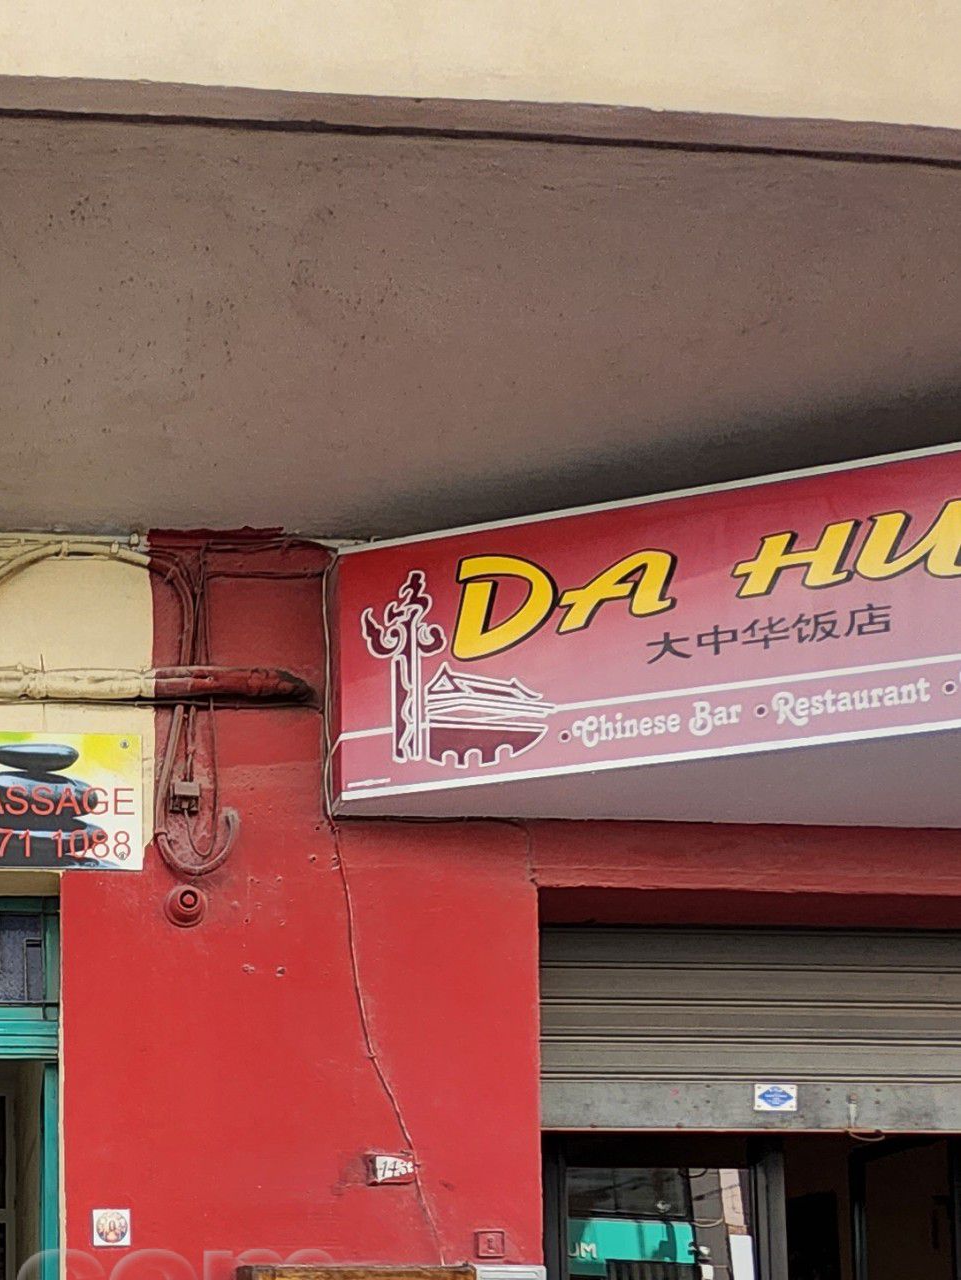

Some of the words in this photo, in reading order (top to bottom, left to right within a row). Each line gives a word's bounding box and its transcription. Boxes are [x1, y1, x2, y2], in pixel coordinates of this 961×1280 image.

[451, 548, 677, 661] DA
[647, 603, 892, 664] 大中华饭店
[571, 714, 681, 748] Chinese
[688, 700, 742, 735] Bar
[772, 676, 931, 726] Restaurant
[52, 829, 132, 861] 1088
